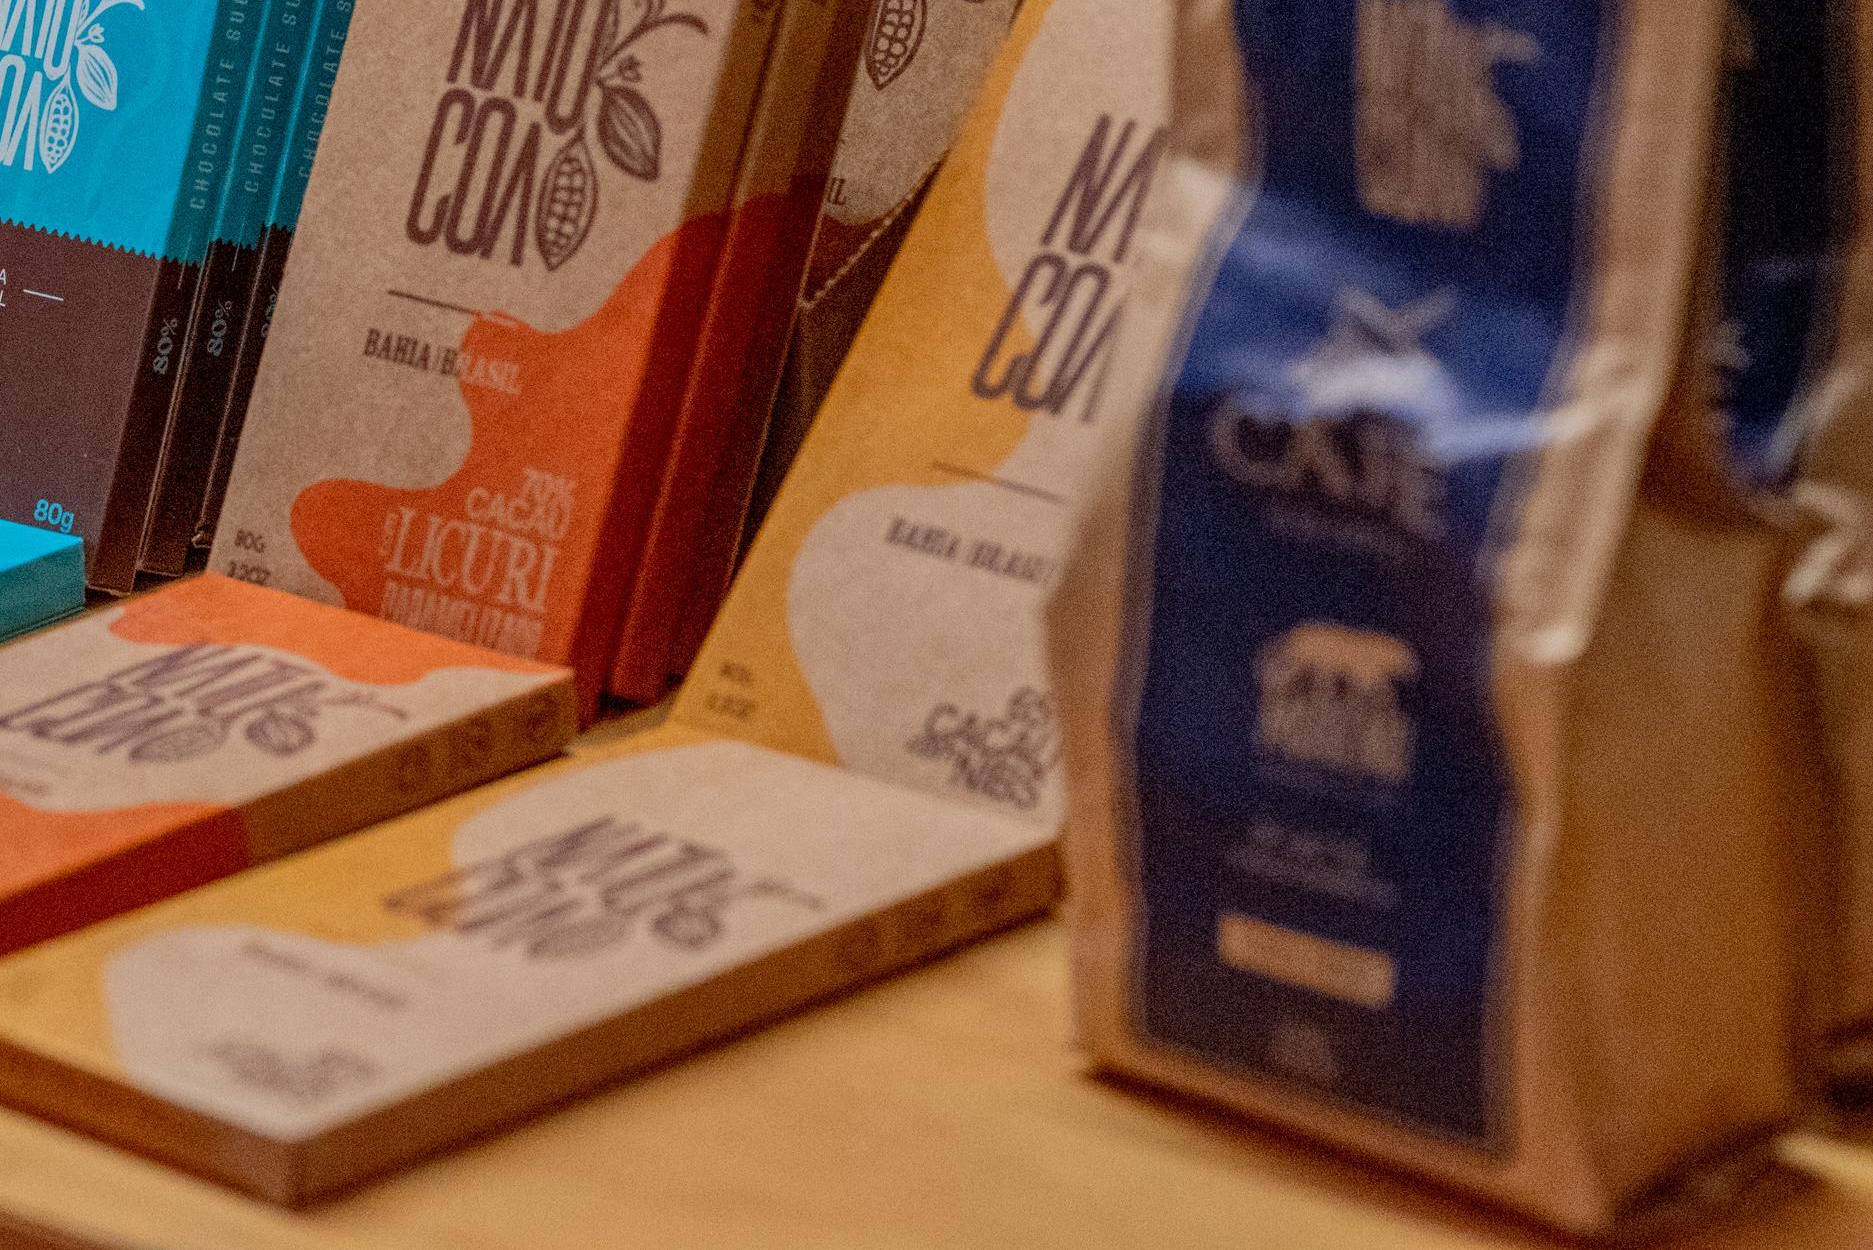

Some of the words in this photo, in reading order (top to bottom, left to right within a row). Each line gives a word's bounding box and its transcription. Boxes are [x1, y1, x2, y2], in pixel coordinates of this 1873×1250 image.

[189, 58, 235, 211] CHOCOLATE
[243, 41, 292, 195] CHOCOLATE
[404, 87, 542, 268] COA
[152, 317, 179, 376] 80%
[207, 299, 233, 358] 80%
[32, 497, 76, 534] 80g
